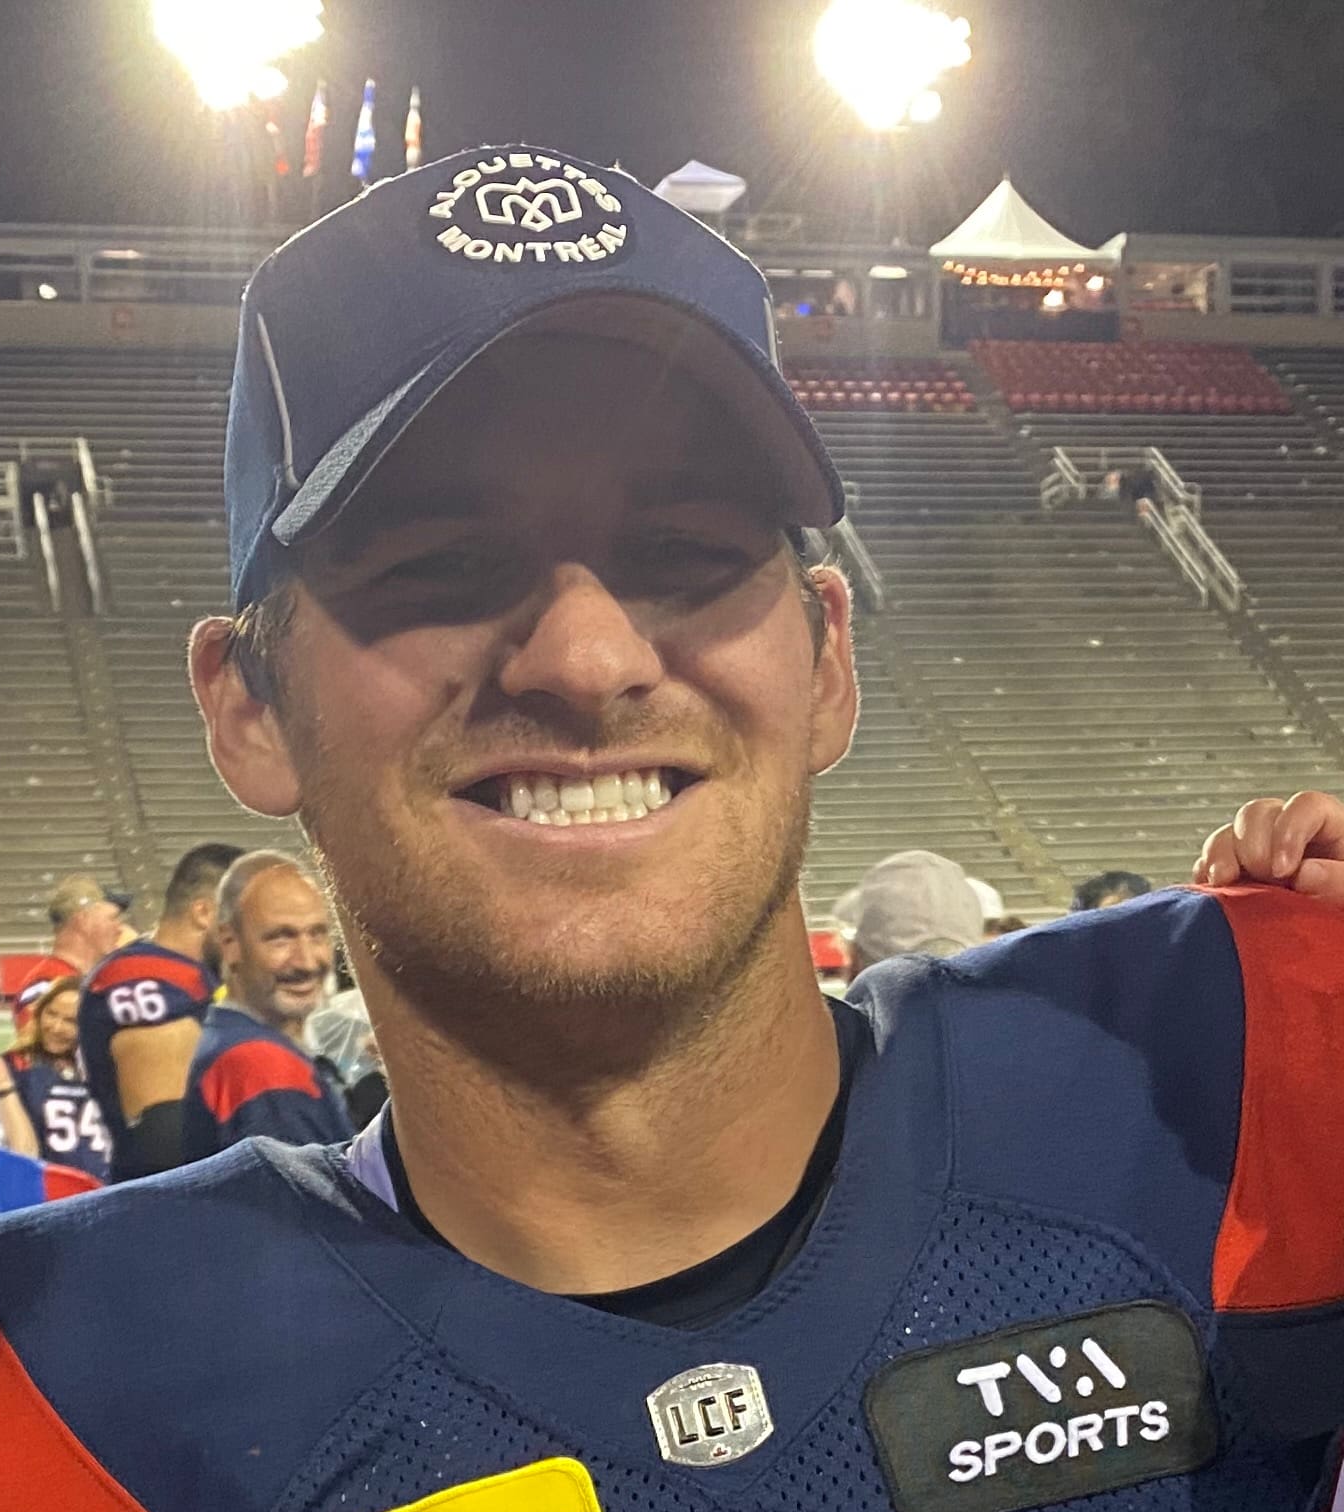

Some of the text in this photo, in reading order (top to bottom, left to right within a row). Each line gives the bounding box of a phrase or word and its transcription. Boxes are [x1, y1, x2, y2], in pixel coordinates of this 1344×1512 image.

[428, 153, 622, 219] ALOUETTES
[436, 222, 628, 263] MONTRÉAL
[109, 979, 167, 1026] 66
[43, 1098, 113, 1153] 54
[957, 1337, 1127, 1417] TVA
[669, 1388, 748, 1446] LCF
[948, 1400, 1170, 1483] SPORTS
